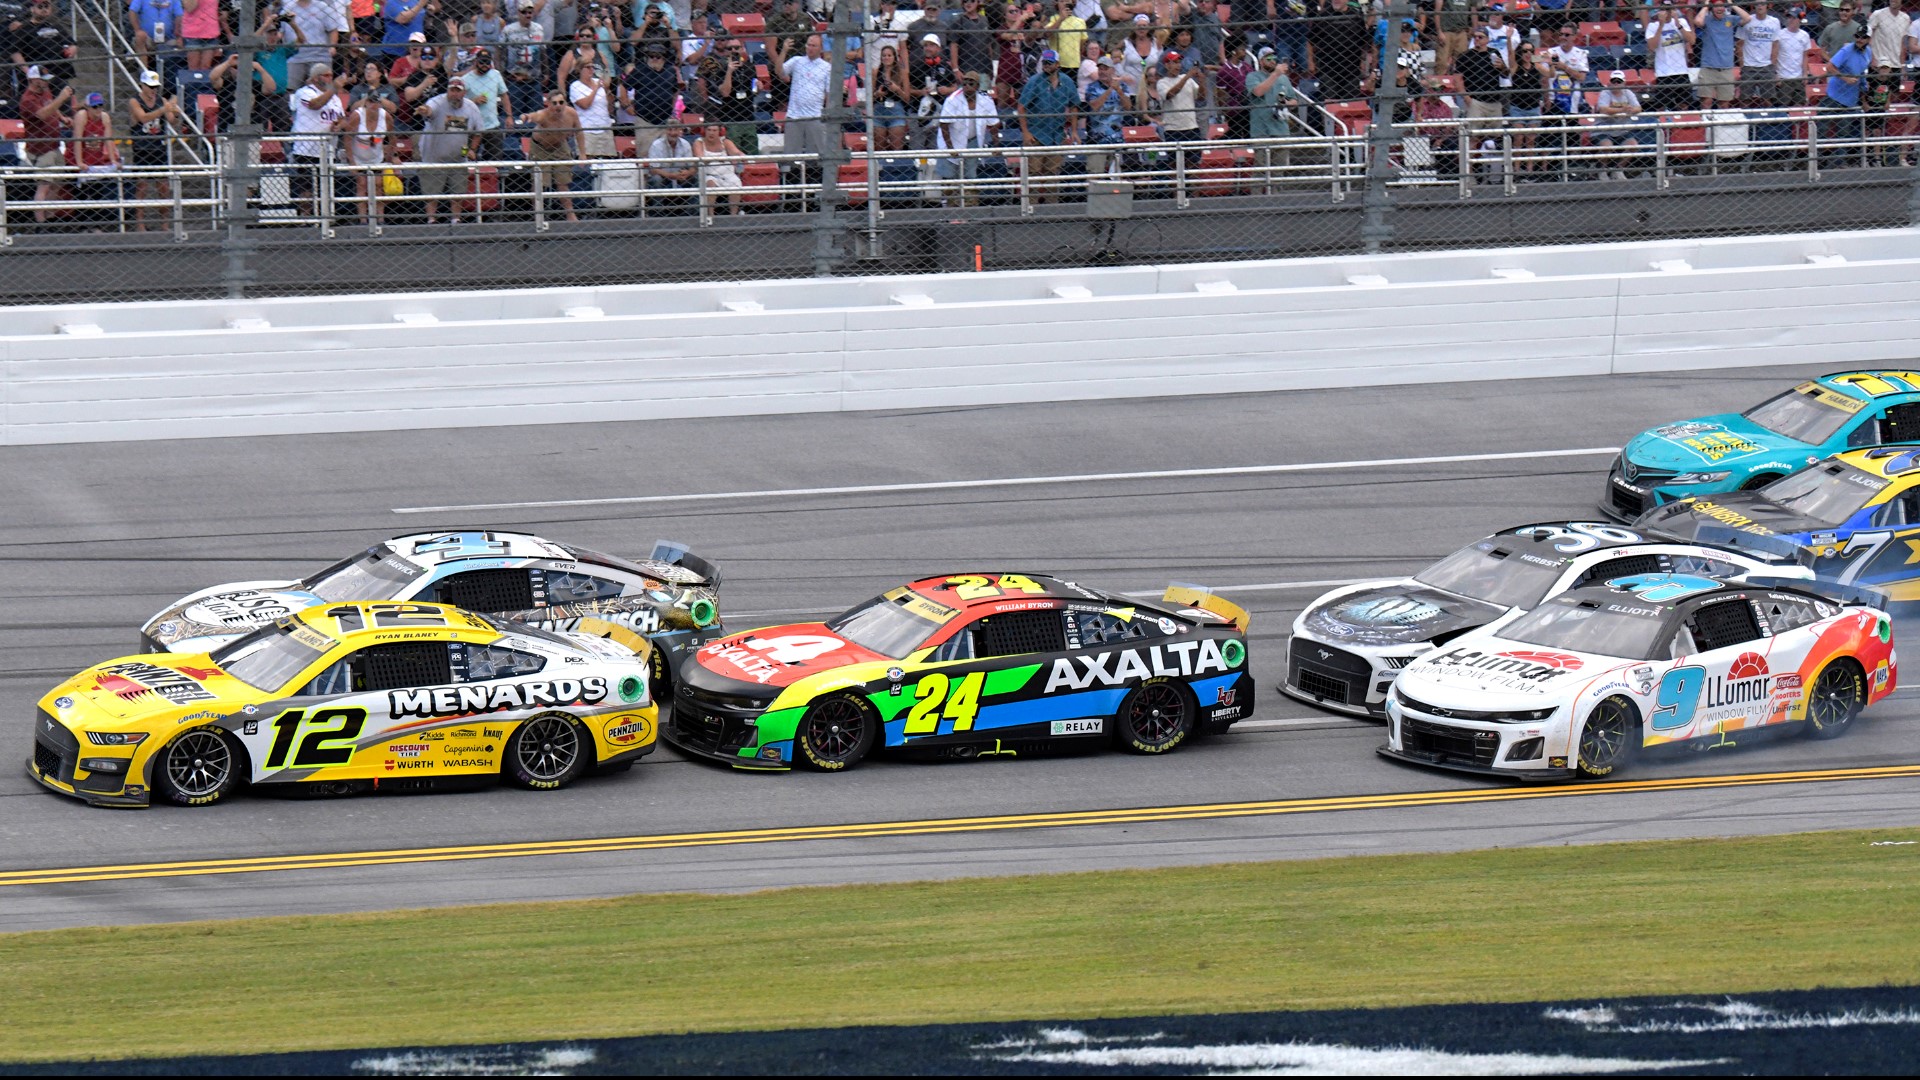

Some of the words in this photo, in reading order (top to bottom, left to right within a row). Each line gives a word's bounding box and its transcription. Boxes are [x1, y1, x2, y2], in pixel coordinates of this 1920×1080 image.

[1748, 461, 1793, 473] GOODYEAR
[1613, 477, 1645, 493] CAMRY
[1848, 473, 1885, 490] LAJOIE
[1520, 553, 1562, 568] HERBST
[1836, 529, 1896, 586] 7
[384, 557, 417, 576] HARVICK
[945, 574, 1047, 600] 24
[918, 601, 948, 616] BYRON
[995, 603, 1026, 611] WILLIAM
[1607, 604, 1658, 617] ELLIOTT
[326, 603, 449, 635] 12
[294, 629, 326, 648] BLANEY
[706, 642, 780, 684] AXALTA
[1044, 638, 1227, 693] AXALTA
[1592, 680, 1630, 697] GOODYEAR
[1707, 675, 1770, 708] LLumar
[1775, 691, 1802, 700] HOOTERS
[389, 676, 608, 719] MENARDS
[845, 693, 869, 712] EAGLE
[903, 671, 987, 734] 24
[1651, 664, 1707, 731] 9
[178, 710, 228, 725] GOODYEAR
[1211, 705, 1242, 718] LIBERTY
[1707, 706, 1745, 722] WINDOW
[1746, 703, 1767, 716] FILM
[1772, 703, 1801, 715] UniFirst
[483, 726, 503, 740] KNAUF
[608, 721, 644, 738] PENNZOIL
[1065, 719, 1101, 732] RELAY
[264, 705, 369, 771] 12
[1132, 730, 1185, 753] GOODYEAR
[389, 743, 430, 752] DISCOUNT
[444, 744, 485, 756] Capgemini
[801, 735, 845, 770] GOODYEAR
[397, 760, 434, 769] WÜRTH
[443, 759, 493, 767] WABASH
